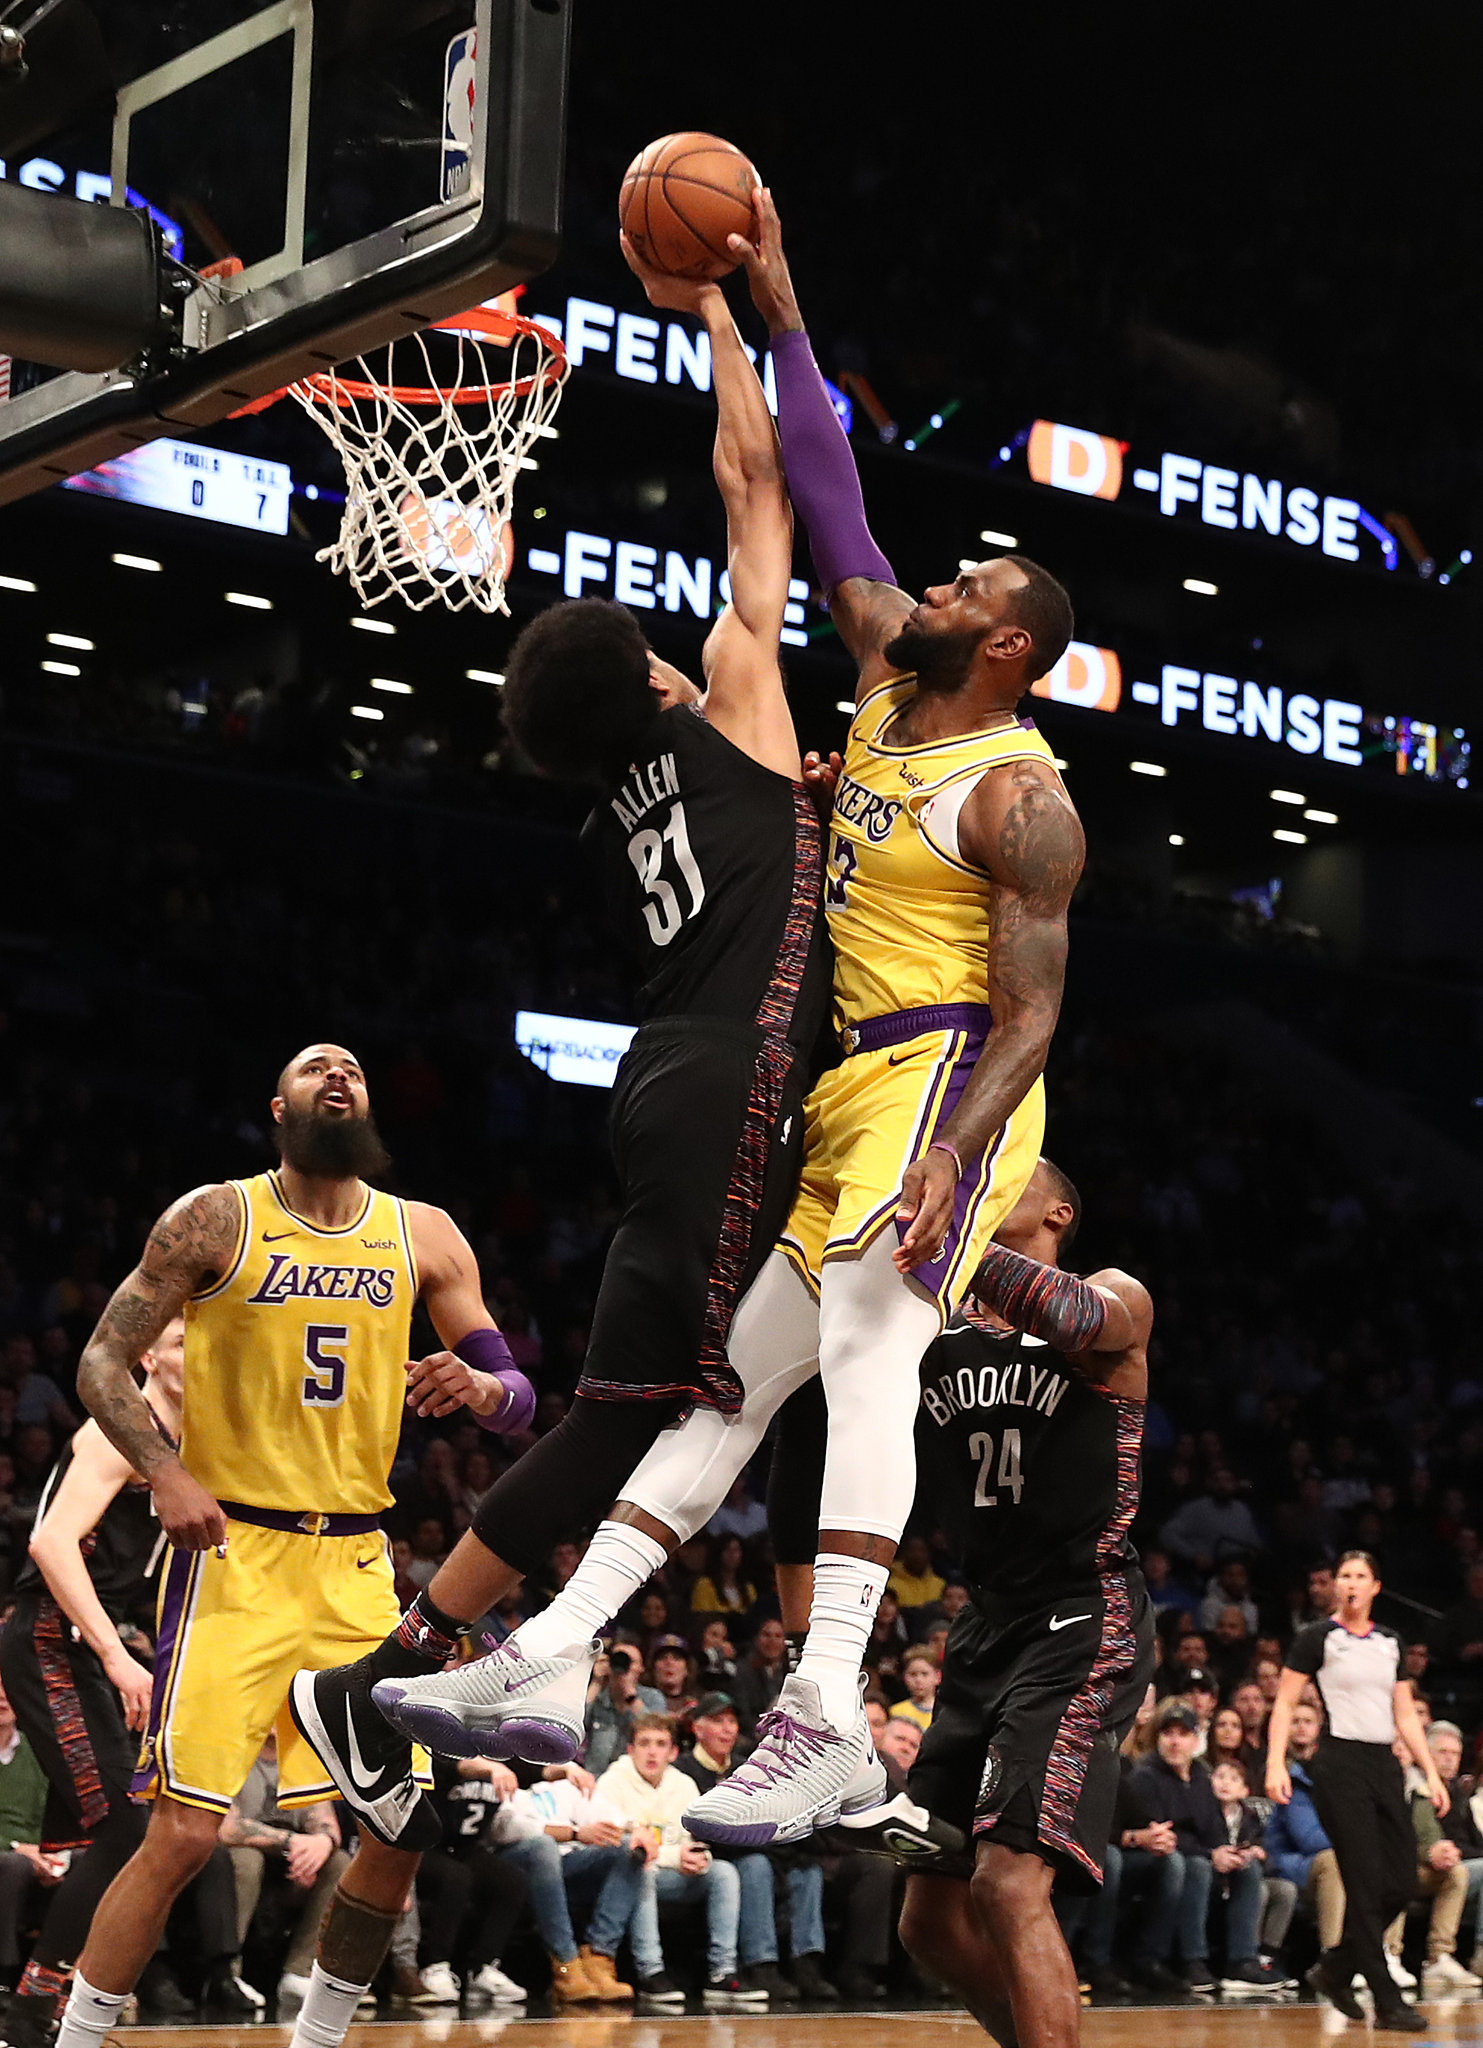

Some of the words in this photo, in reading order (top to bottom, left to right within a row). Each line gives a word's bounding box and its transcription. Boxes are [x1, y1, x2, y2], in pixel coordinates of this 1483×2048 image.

[533, 296, 779, 416] -FEN
[257, 493, 267, 520] 7
[1051, 423, 1107, 496] D
[1133, 452, 1361, 562] -FENSE
[528, 530, 810, 648] -FENE
[1050, 640, 1107, 710] D
[1132, 654, 1364, 767] -FENSE
[610, 752, 681, 834] ALLEN
[834, 774, 904, 844] KERS
[627, 800, 706, 946] 31
[825, 834, 858, 913] 3
[245, 1253, 397, 1309] LAKERS
[360, 1238, 397, 1250] wish
[301, 1323, 349, 1408] 5
[922, 1363, 1070, 1427] BROOKLYN
[968, 1428, 1025, 1508] 24
[460, 1803, 485, 1836] 2
